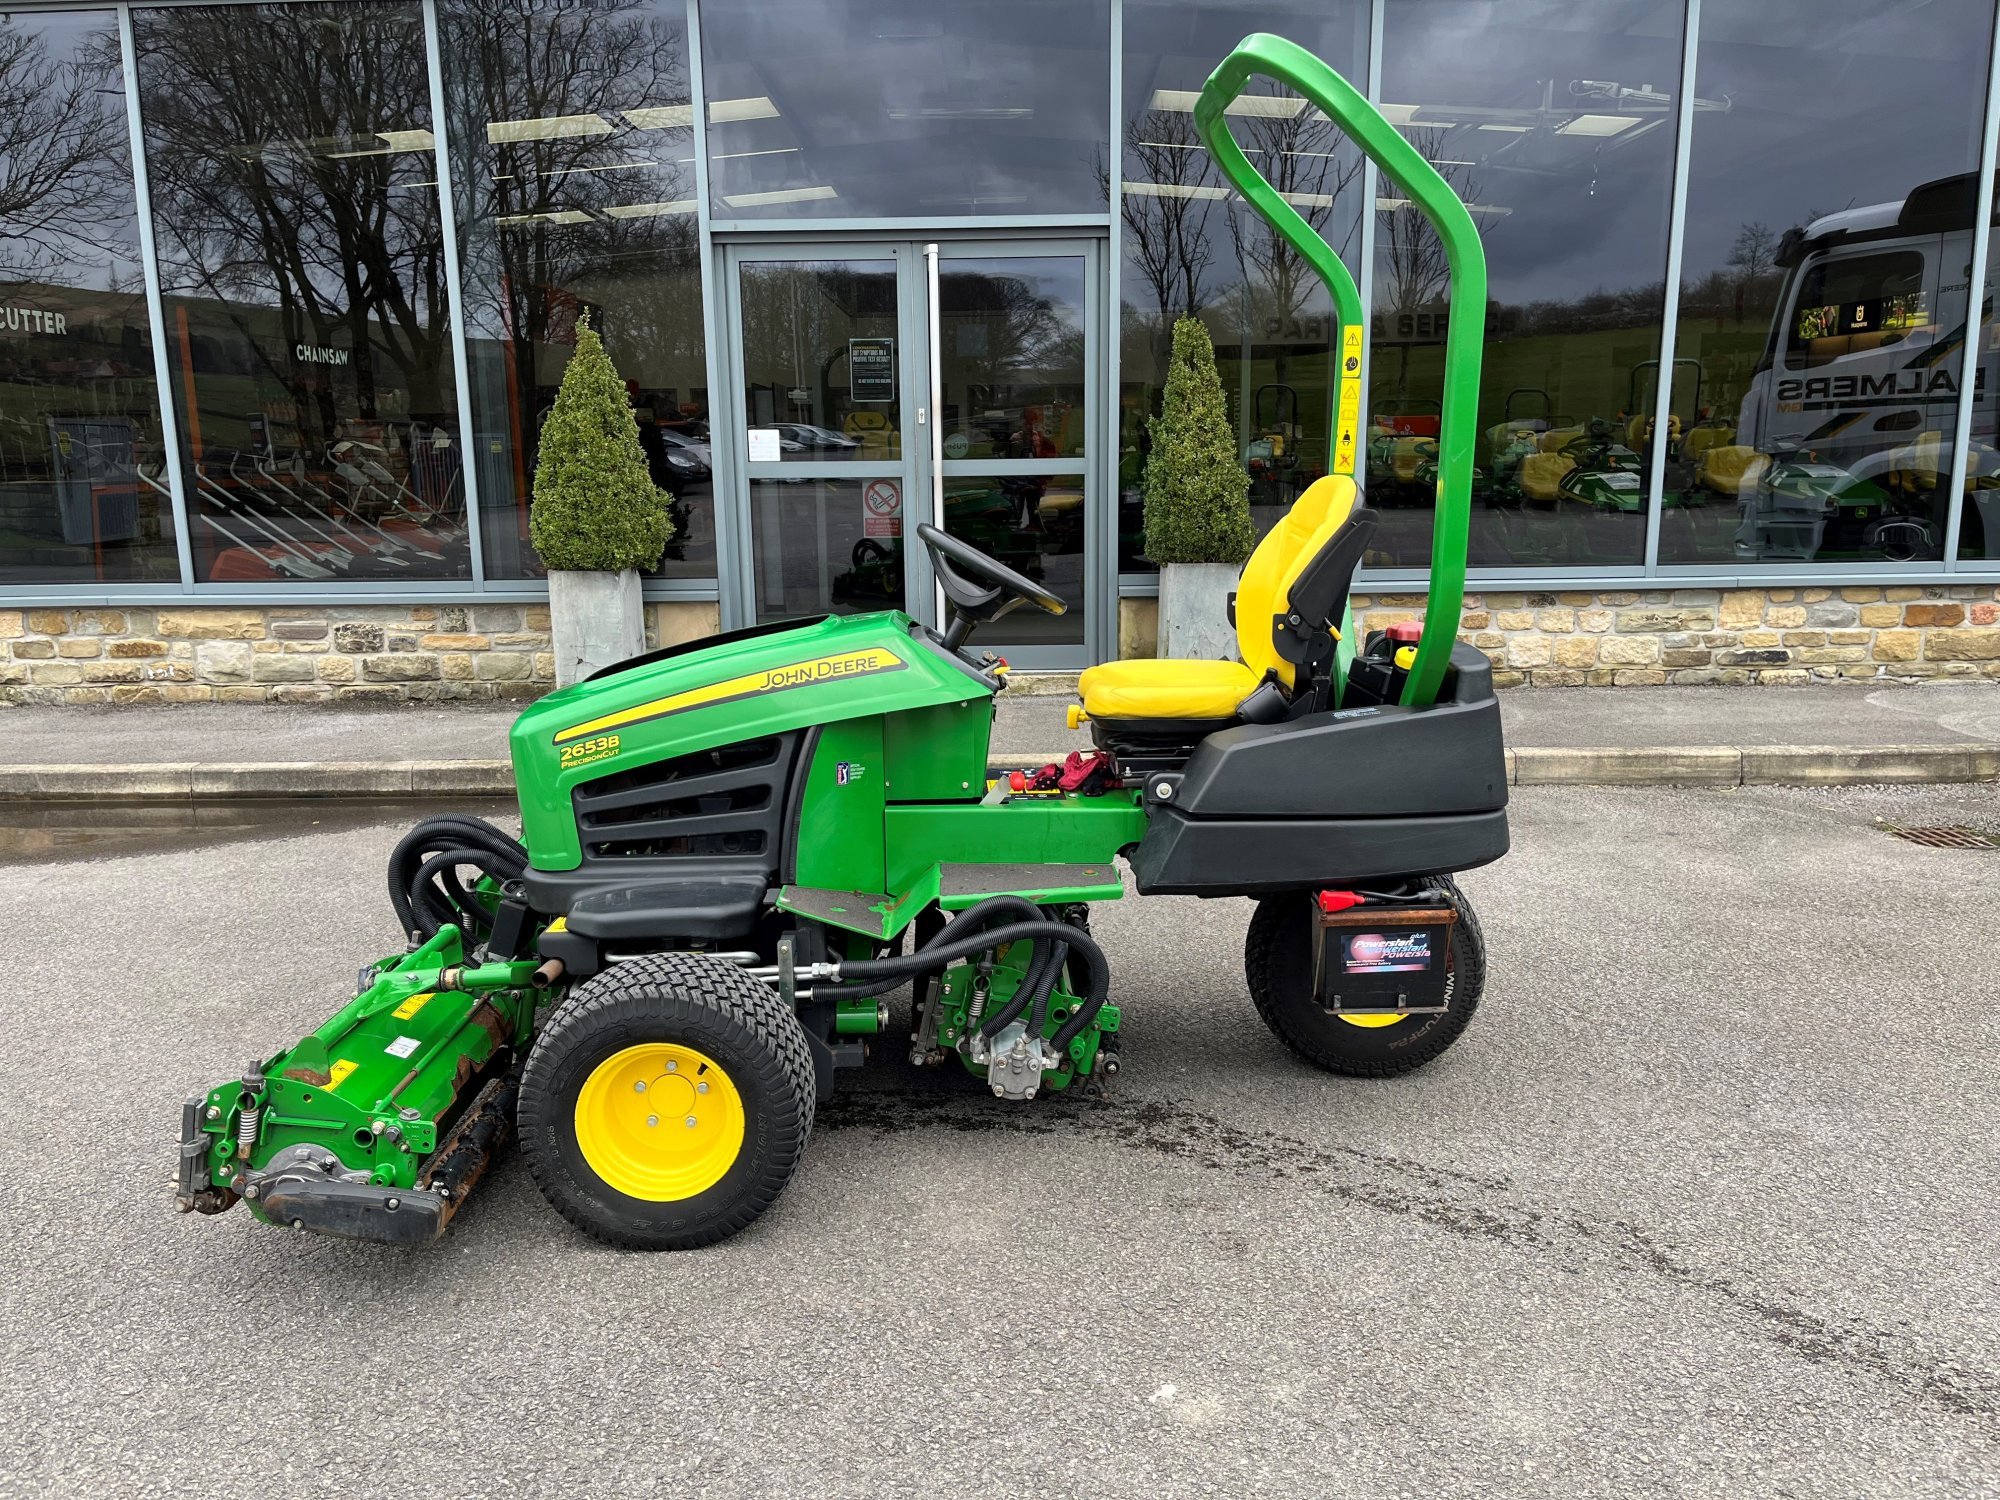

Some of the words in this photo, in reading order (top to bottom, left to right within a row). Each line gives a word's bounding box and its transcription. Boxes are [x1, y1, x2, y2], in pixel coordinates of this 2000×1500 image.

[0, 306, 68, 335] CUTTER
[296, 343, 348, 366] CHAINSAW
[760, 667, 812, 689] JOHN
[817, 656, 879, 677] DEERE
[560, 735, 620, 761] 2653B
